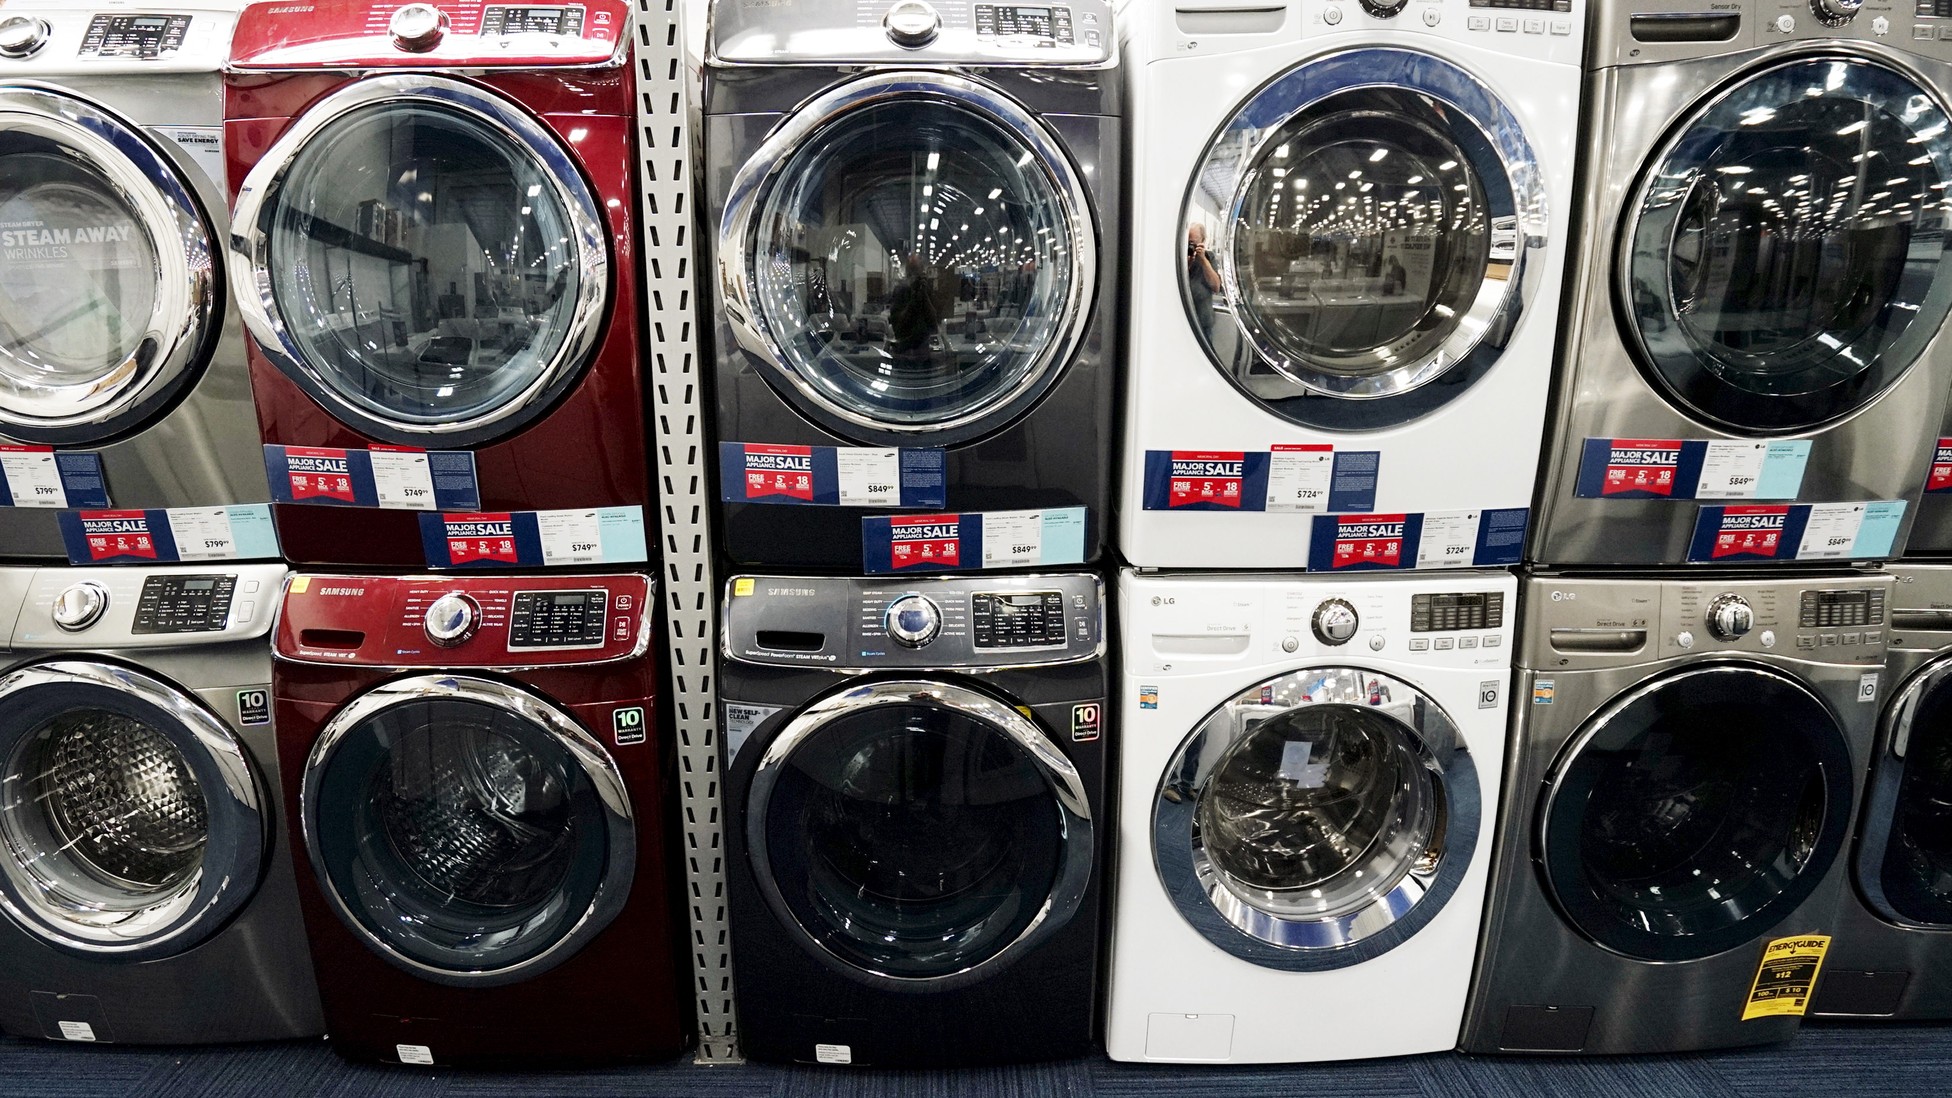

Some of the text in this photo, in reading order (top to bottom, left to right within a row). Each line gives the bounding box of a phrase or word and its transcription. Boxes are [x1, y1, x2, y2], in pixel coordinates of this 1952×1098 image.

[267, 6, 315, 14] SAMSUNG
[1731, 3, 1742, 12] Dry
[2, 225, 130, 247] STEAM AWAY
[4, 246, 68, 260] WRINKLES
[745, 455, 775, 463] MAJOR
[1611, 451, 1642, 459] MAJOR
[1641, 451, 1679, 464] SALE
[288, 457, 315, 466] MAJOR
[315, 459, 348, 472] SALE
[775, 456, 811, 470] SALE
[1173, 462, 1204, 471] MAJOR
[1205, 462, 1243, 476] SALE
[748, 473, 765, 481] FREE
[1659, 470, 1671, 479] 18
[336, 478, 348, 487] 18
[796, 475, 809, 485] 18
[1225, 481, 1238, 491] 18
[112, 520, 148, 532] SALE
[1750, 516, 1786, 528] SALE
[476, 523, 513, 535] SALE
[892, 527, 922, 535] MAJOR
[923, 525, 959, 538] SALE
[1338, 525, 1368, 533] MAJOR
[1368, 524, 1404, 537] SALE
[136, 536, 149, 545] 18
[1766, 533, 1777, 542] 18
[499, 540, 511, 549] 18
[894, 544, 911, 552] FREE
[943, 542, 955, 552] 18
[1386, 542, 1398, 551] 18
[319, 587, 365, 596] SAMSUNG
[767, 588, 815, 597] SAMSUNG
[1563, 592, 1576, 600] LG
[1163, 597, 1175, 605] LG
[1861, 684, 1874, 696] 10
[241, 692, 264, 708] 10
[1481, 690, 1496, 703] 10
[617, 710, 640, 727] 10
[1076, 706, 1096, 723] 10
